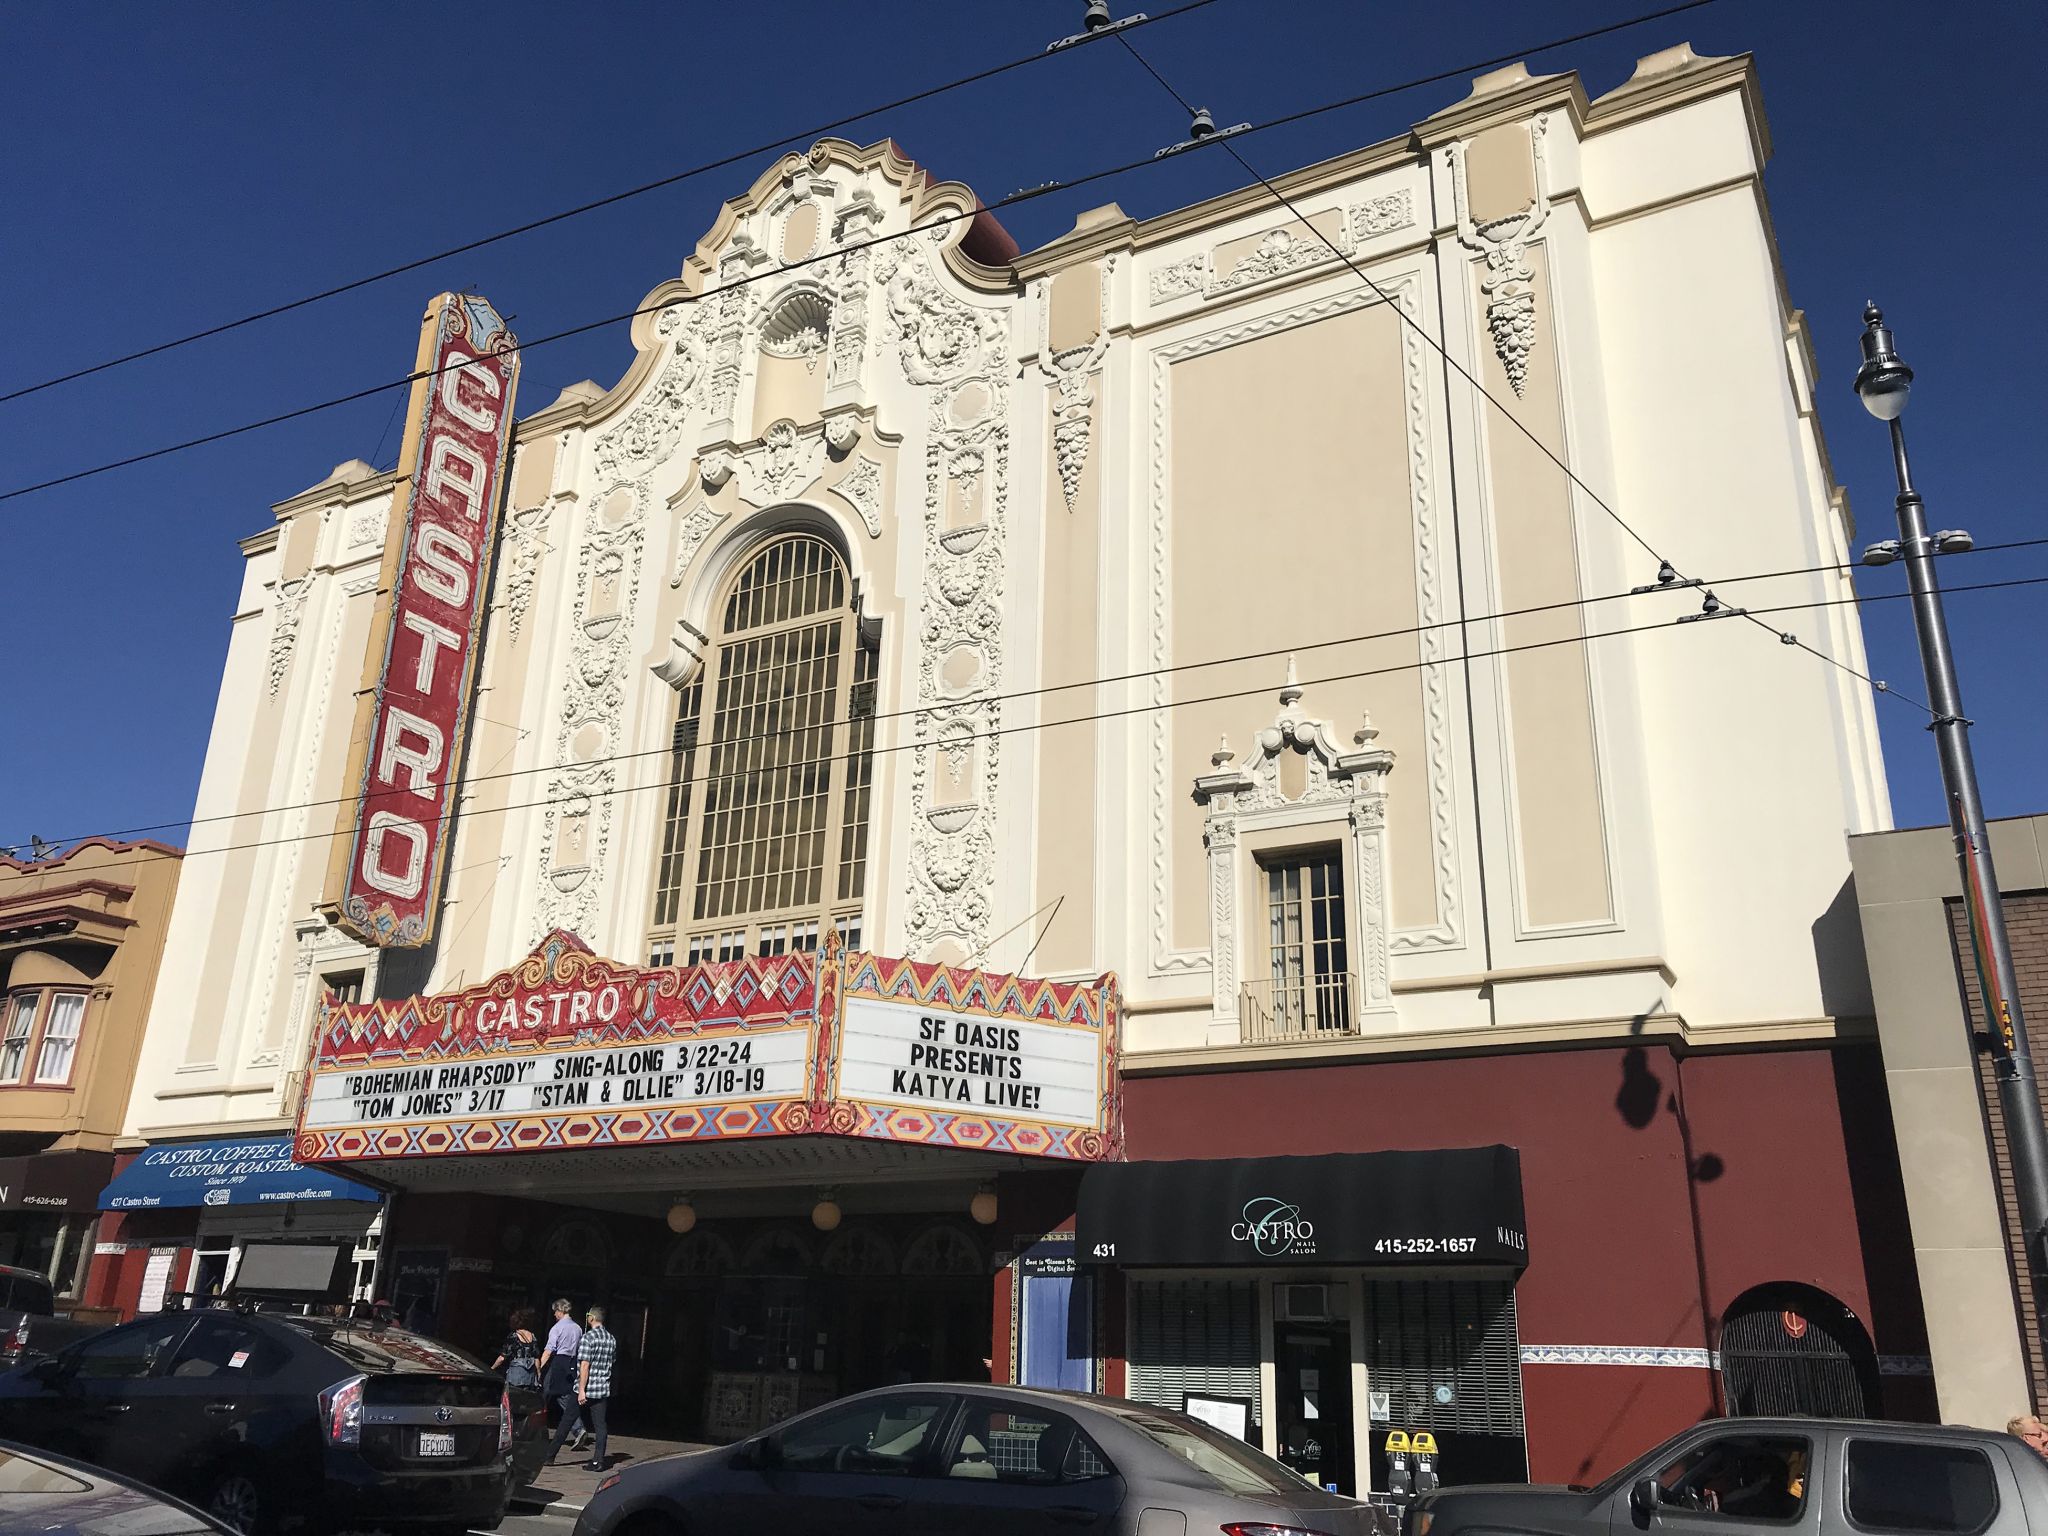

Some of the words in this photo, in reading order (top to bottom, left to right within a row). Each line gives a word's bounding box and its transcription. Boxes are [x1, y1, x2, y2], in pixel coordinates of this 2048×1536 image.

[362, 350, 501, 899] CASTRO
[476, 986, 619, 1033] CASTRO
[920, 1017, 946, 1041] SF
[955, 1022, 1020, 1051] OASIS
[345, 1068, 434, 1096] "BOHEMIAN
[437, 1061, 536, 1089] RHAPSODY"
[553, 1049, 665, 1080] SING-ALONG
[677, 1041, 752, 1069] 3/22-24
[910, 1043, 1022, 1079] PRESENTS
[353, 1097, 393, 1120] "TOM
[401, 1093, 462, 1116] JONES"
[468, 1089, 505, 1112] 3/17
[533, 1082, 589, 1107] "STAN
[600, 1080, 611, 1103] &
[622, 1074, 684, 1101] OLLIE"
[694, 1067, 765, 1095] 3/18-19
[892, 1069, 971, 1102] KATYA
[985, 1081, 1041, 1109] LIVE!
[144, 1149, 212, 1166] CASTRO
[212, 1144, 280, 1161] COFFEE
[169, 1162, 233, 1178] CUSTOM
[204, 1176, 228, 1185] Since
[22, 1196, 67, 1206] 415-626-6268
[111, 1197, 122, 1207] 427
[122, 1197, 142, 1207] Castro
[143, 1196, 160, 1206] Street
[259, 1188, 332, 1200] www.castro-coffee.com
[1230, 1221, 1314, 1241] CASTRO
[1497, 1226, 1525, 1251] NAILS
[1093, 1243, 1115, 1257] 431
[1374, 1237, 1477, 1253] 415-252-1657
